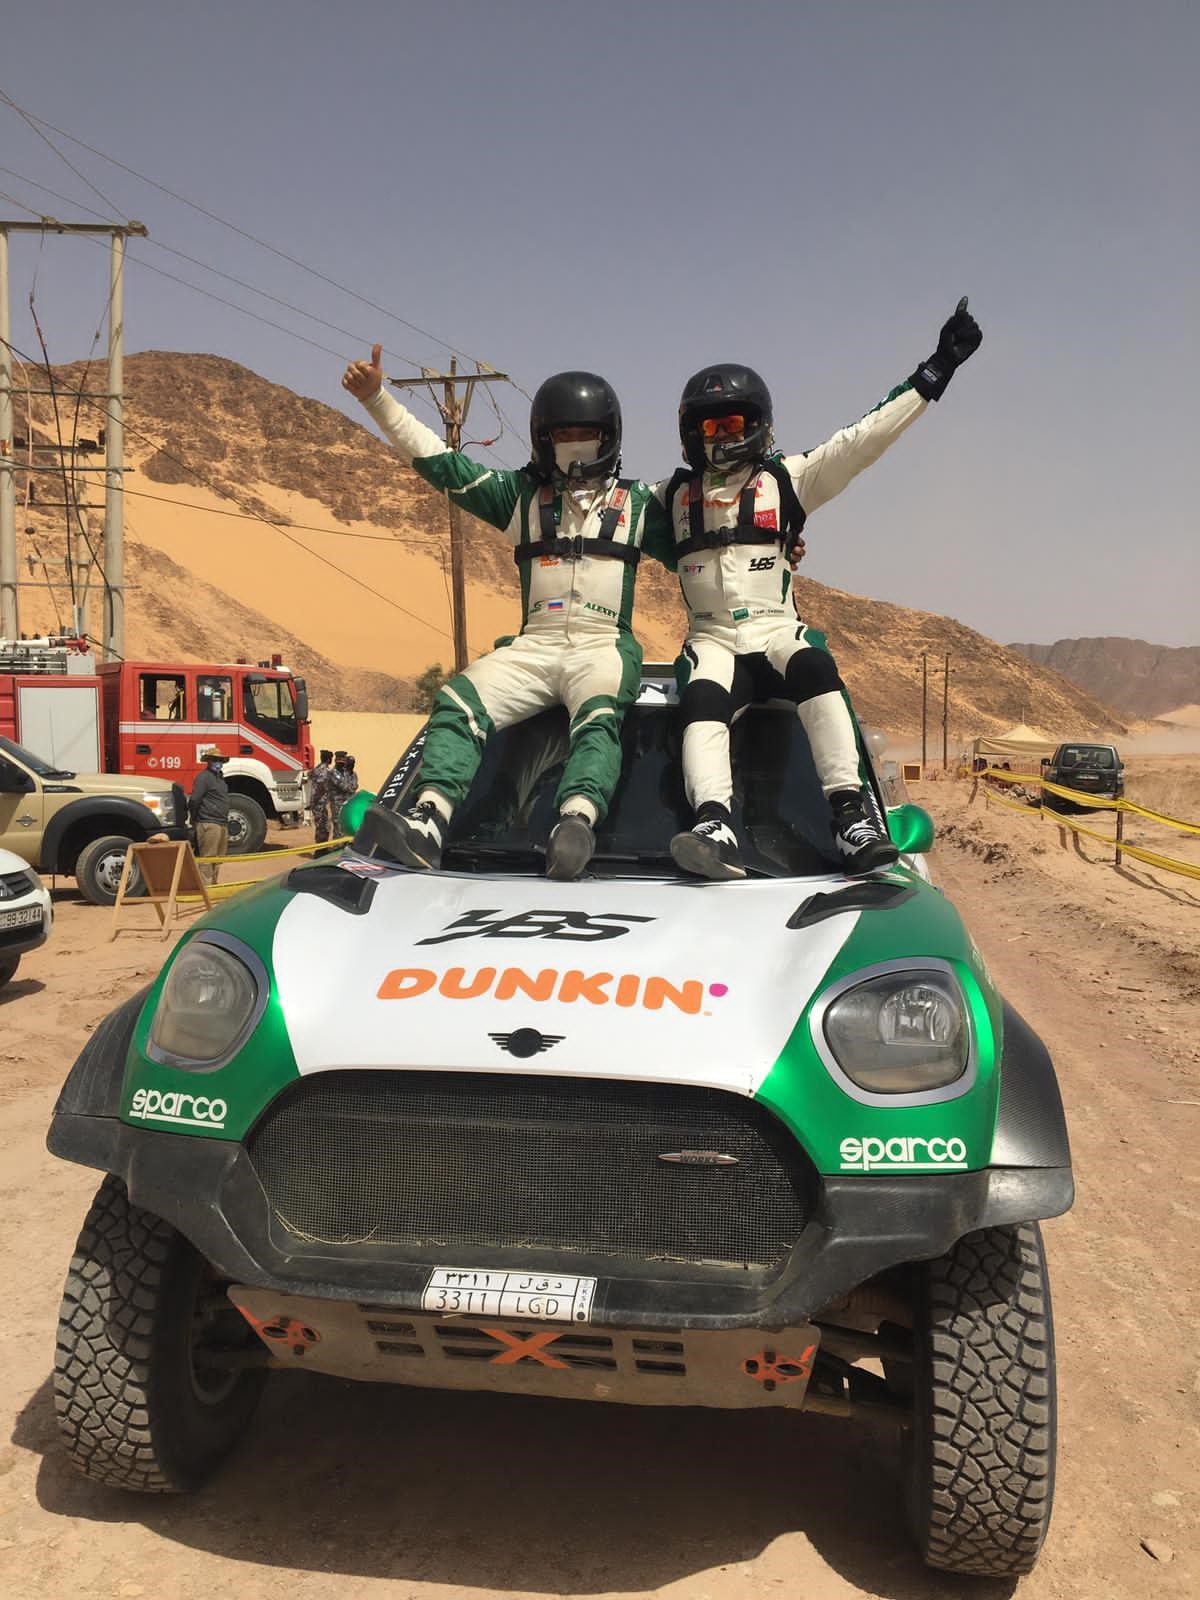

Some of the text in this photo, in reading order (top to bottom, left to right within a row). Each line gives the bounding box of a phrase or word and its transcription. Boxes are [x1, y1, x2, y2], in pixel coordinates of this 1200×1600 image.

[584, 602, 617, 618] ALEXEY
[160, 756, 181, 769] 199
[130, 1088, 227, 1125] sparco
[839, 1137, 967, 1170] sparco
[435, 1289, 487, 1312] 3311
[516, 1296, 559, 1316] LGD
